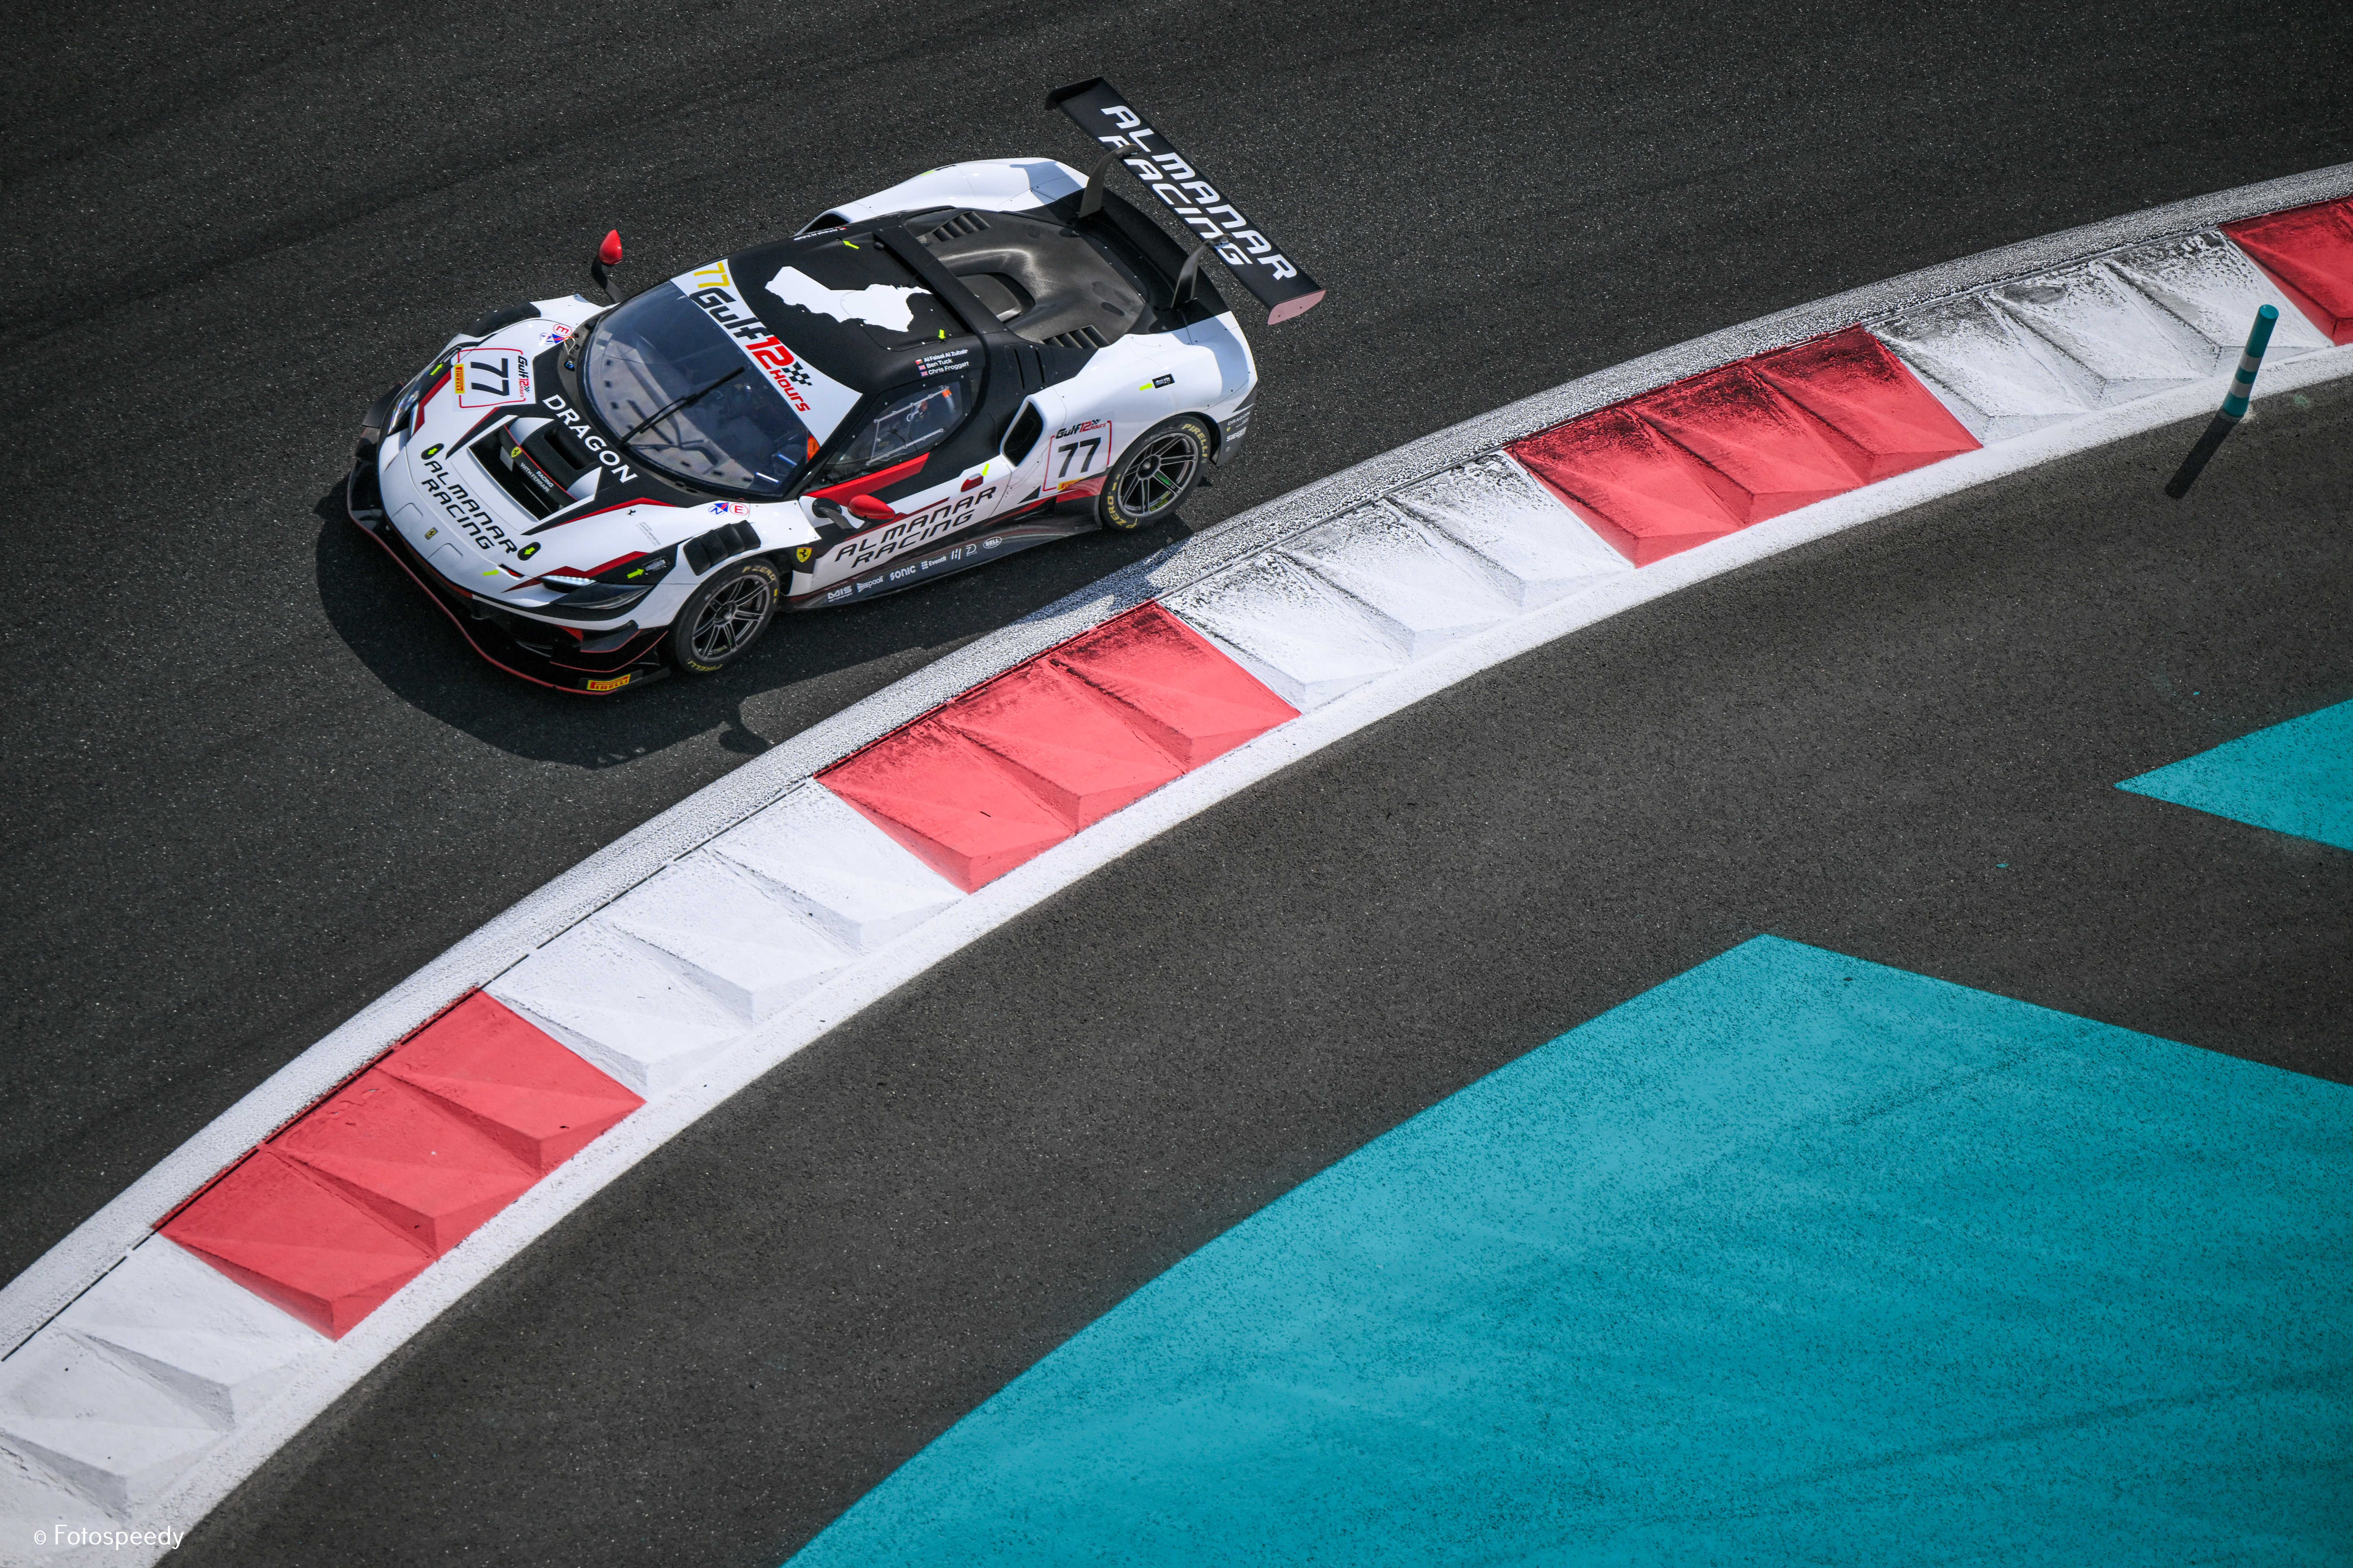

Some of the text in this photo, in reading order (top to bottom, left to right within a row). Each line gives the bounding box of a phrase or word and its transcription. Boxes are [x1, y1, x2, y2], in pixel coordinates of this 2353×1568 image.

[693, 261, 730, 289] 77
[689, 287, 774, 340] Gulf
[745, 336, 794, 370] 12
[470, 358, 510, 396] 77
[518, 355, 528, 378] Gulf
[944, 361, 969, 371] Froggatt
[1055, 423, 1081, 439] Gulf
[1228, 410, 1250, 426] DRAGON
[542, 394, 638, 484] DRAGON
[1181, 423, 1208, 457] PIRELLI
[1058, 437, 1101, 478] 77
[521, 462, 550, 492] WITH FERRARI
[536, 471, 554, 488] RACING
[421, 478, 495, 550] RACING
[1107, 495, 1127, 526] ZERO
[851, 509, 975, 568] RACING
[985, 539, 1000, 547] BELL
[928, 556, 947, 567] EventR
[590, 675, 629, 690] PIRELLI
